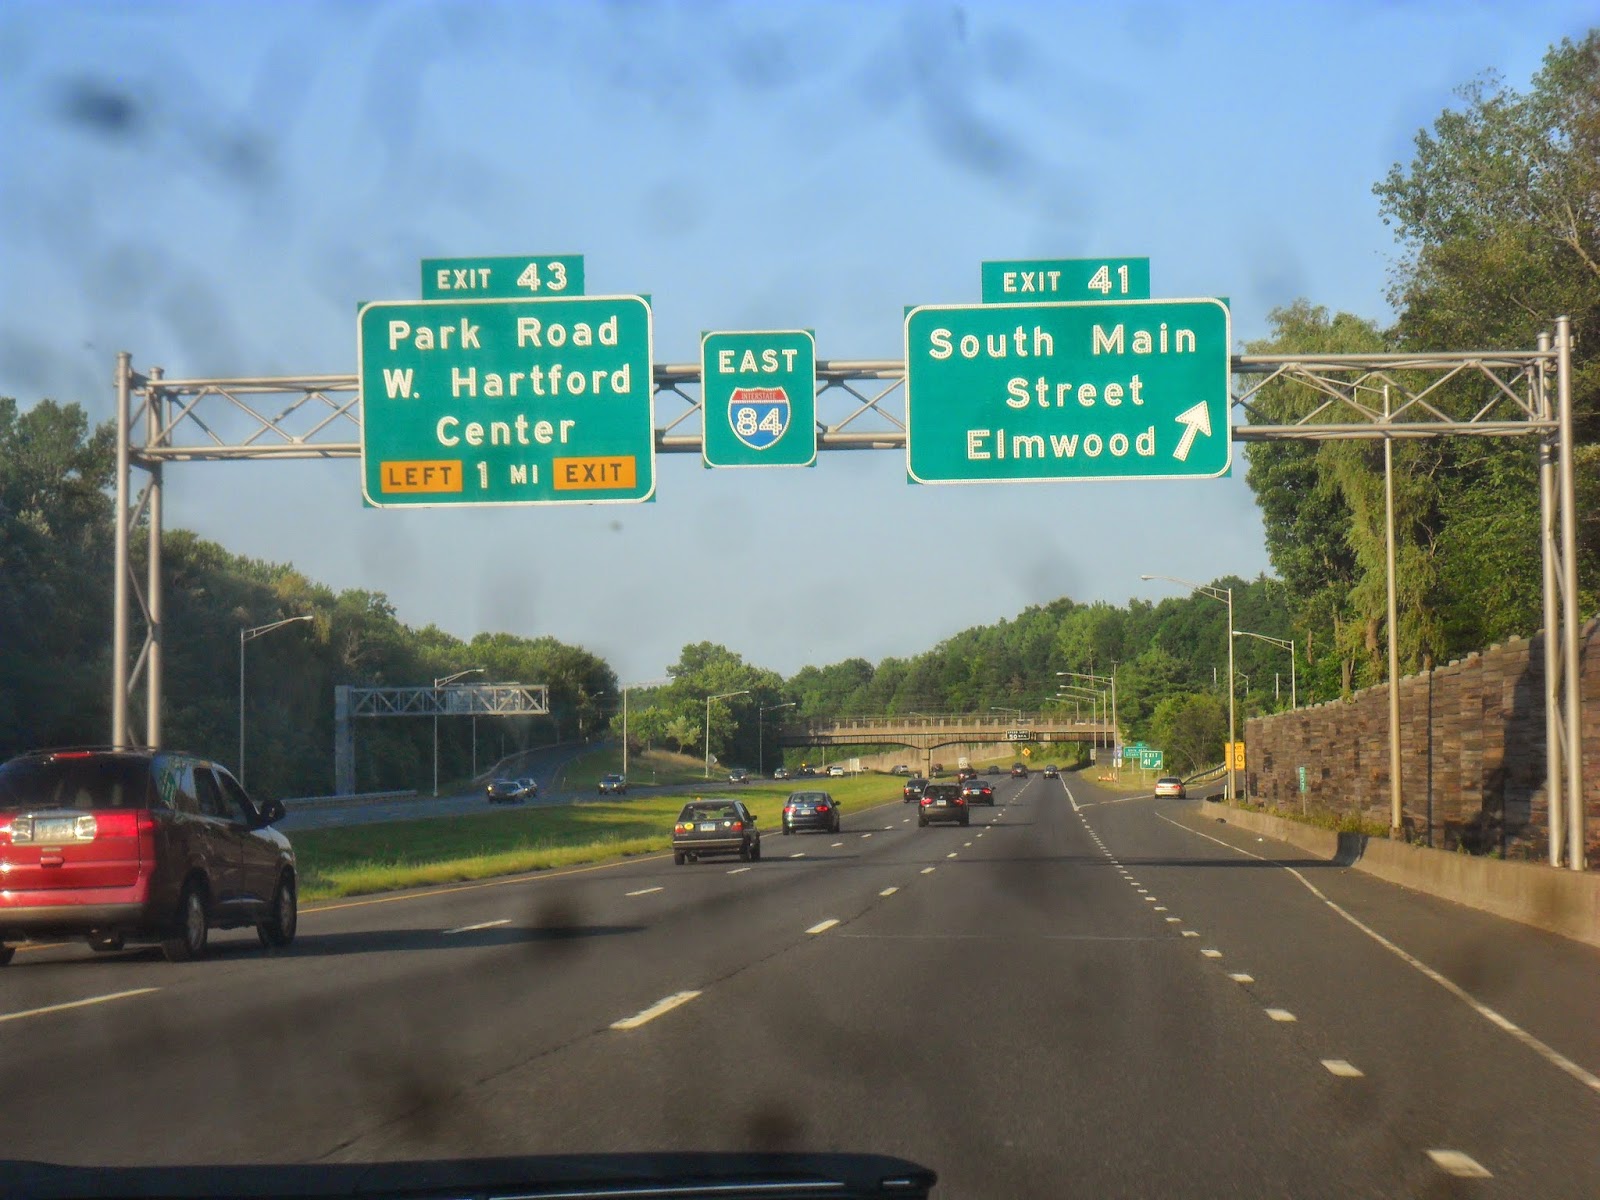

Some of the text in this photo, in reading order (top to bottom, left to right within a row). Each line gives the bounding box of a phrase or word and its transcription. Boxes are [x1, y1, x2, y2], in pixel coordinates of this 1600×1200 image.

[437, 262, 568, 291] EXIT 43
[1003, 265, 1129, 294] EXIT 41
[388, 315, 618, 350] Park Road
[928, 323, 1196, 360] South Main
[718, 349, 798, 373] EAST
[383, 363, 631, 399] W. Hartford
[741, 391, 776, 400] INTERSTATE
[1006, 374, 1144, 409] Street
[436, 414, 576, 447] Center
[736, 407, 783, 436] 84
[966, 425, 1156, 460] Elmwood
[388, 461, 622, 489] LEFT 1 MI EXIT
[1143, 758, 1151, 766] 41
